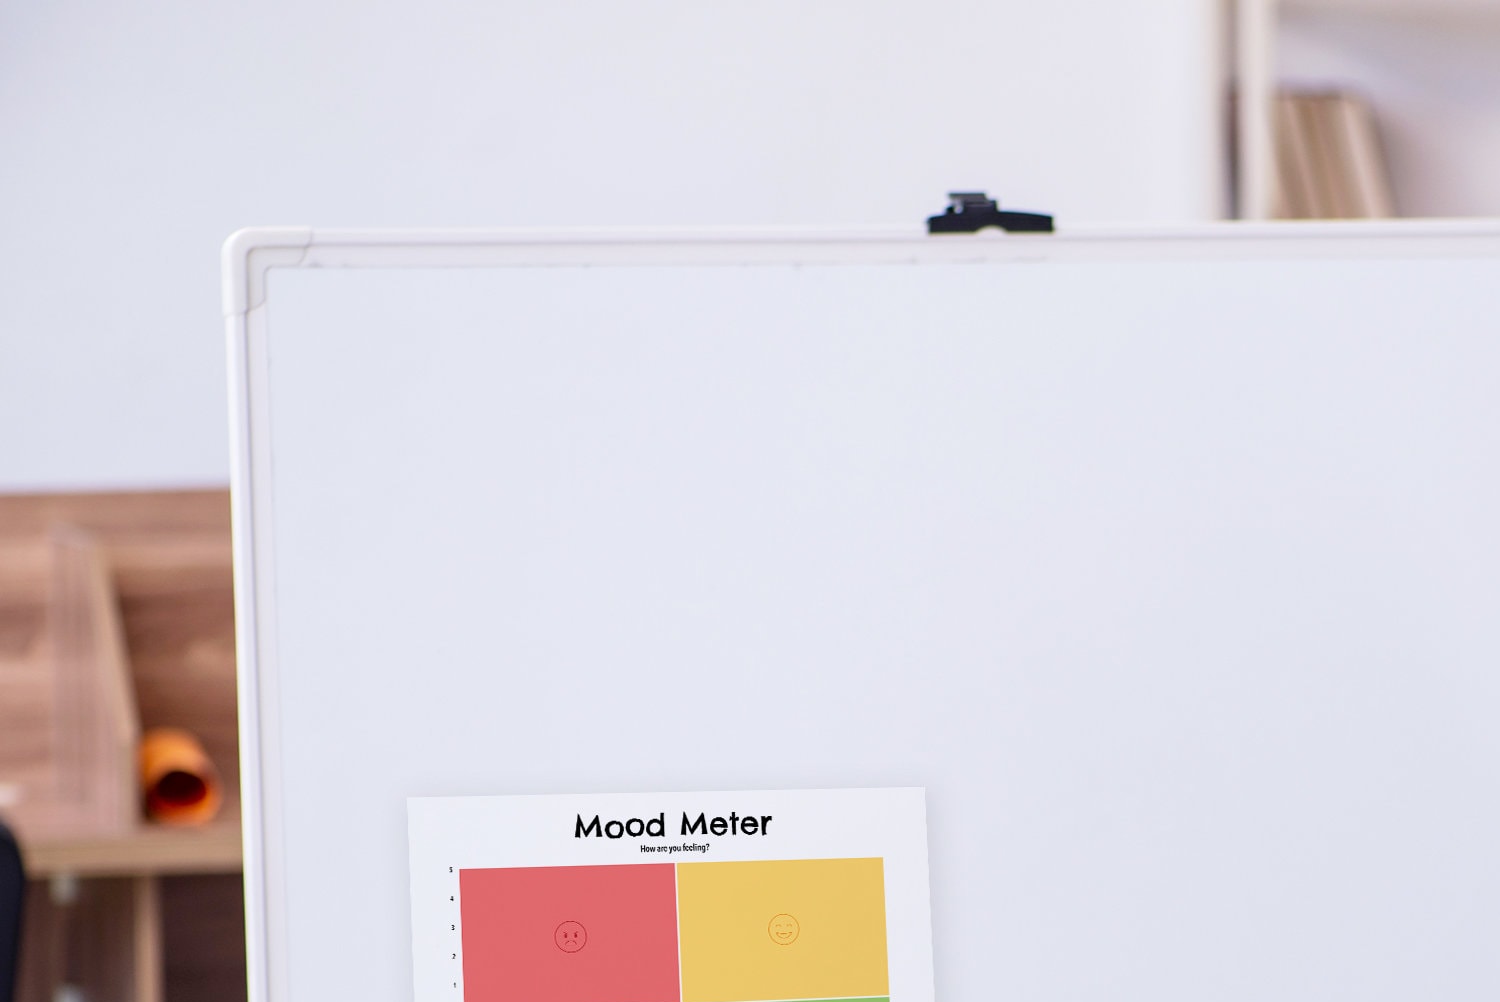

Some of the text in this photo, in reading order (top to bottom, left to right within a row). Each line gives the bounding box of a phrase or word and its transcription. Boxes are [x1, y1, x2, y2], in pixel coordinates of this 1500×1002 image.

[575, 811, 772, 839] Mood Meter
[640, 843, 710, 854] How are you feeling?
